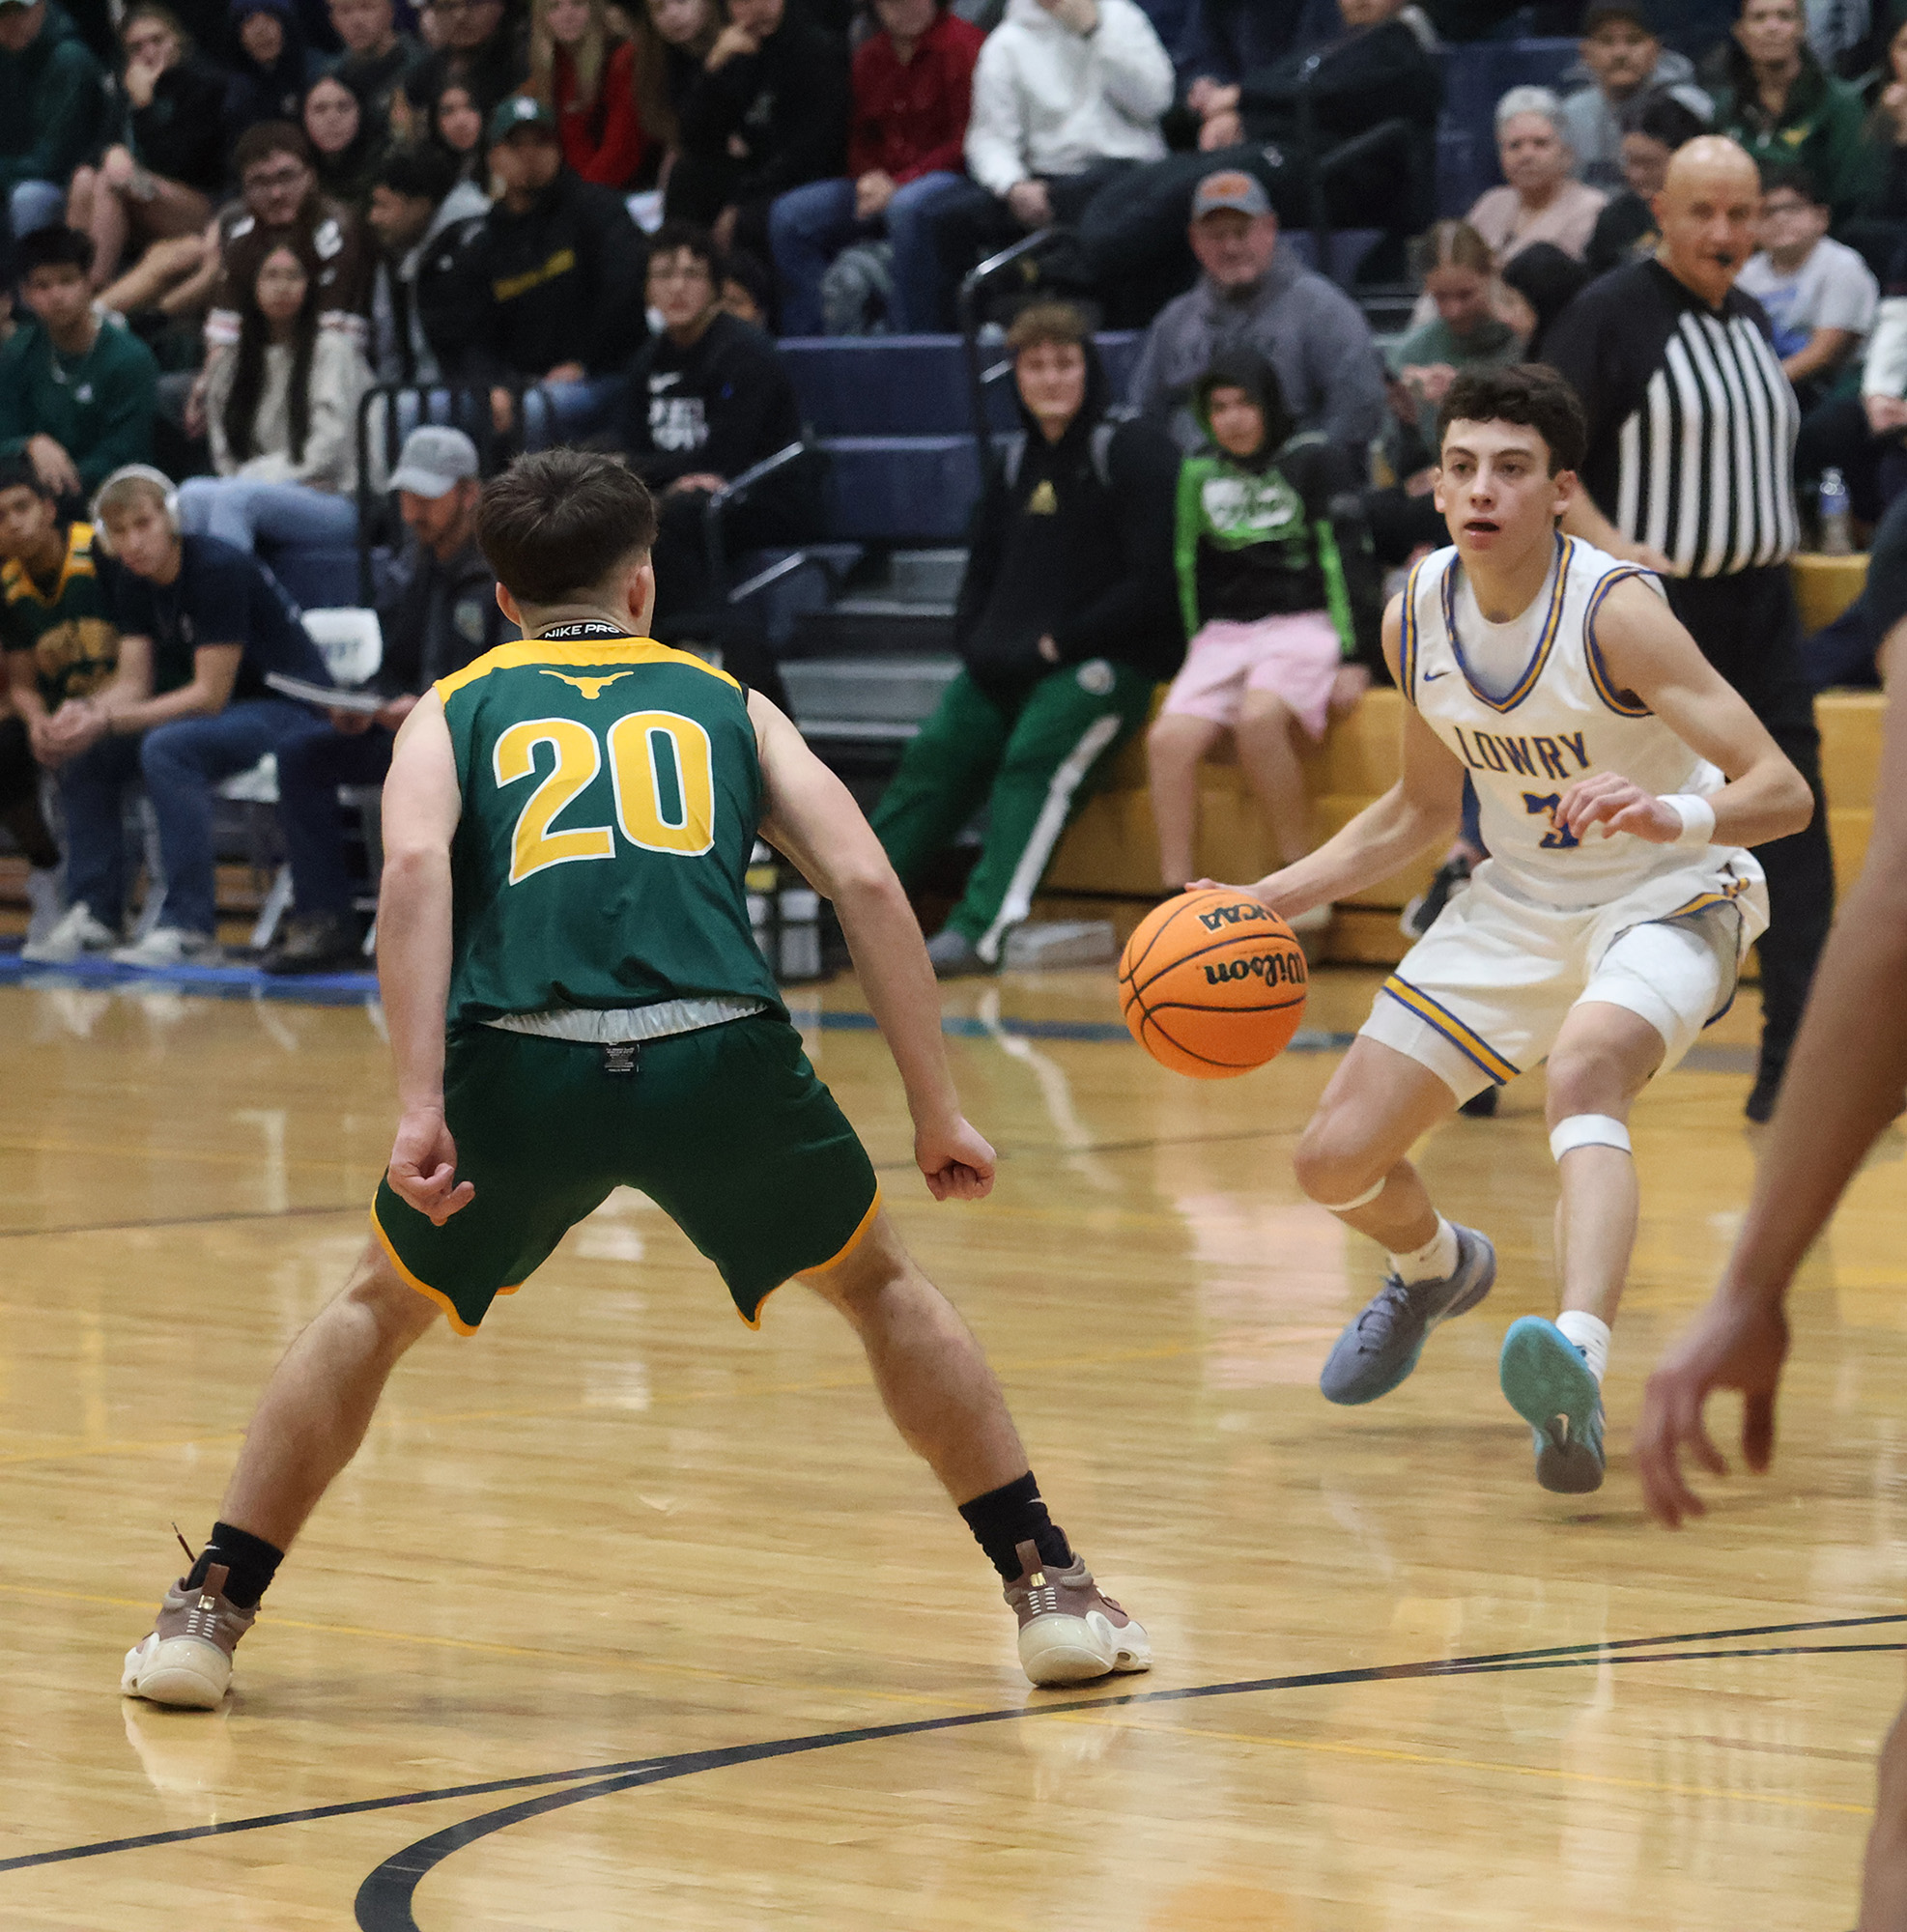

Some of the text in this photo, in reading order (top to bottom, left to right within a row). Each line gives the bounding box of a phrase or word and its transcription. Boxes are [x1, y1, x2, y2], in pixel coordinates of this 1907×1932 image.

[545, 624, 583, 638] NIKE
[1454, 726, 1589, 780] LOWRY
[493, 710, 715, 887] 20
[1197, 903, 1279, 932] NCAA
[1204, 952, 1305, 987] Wilson
